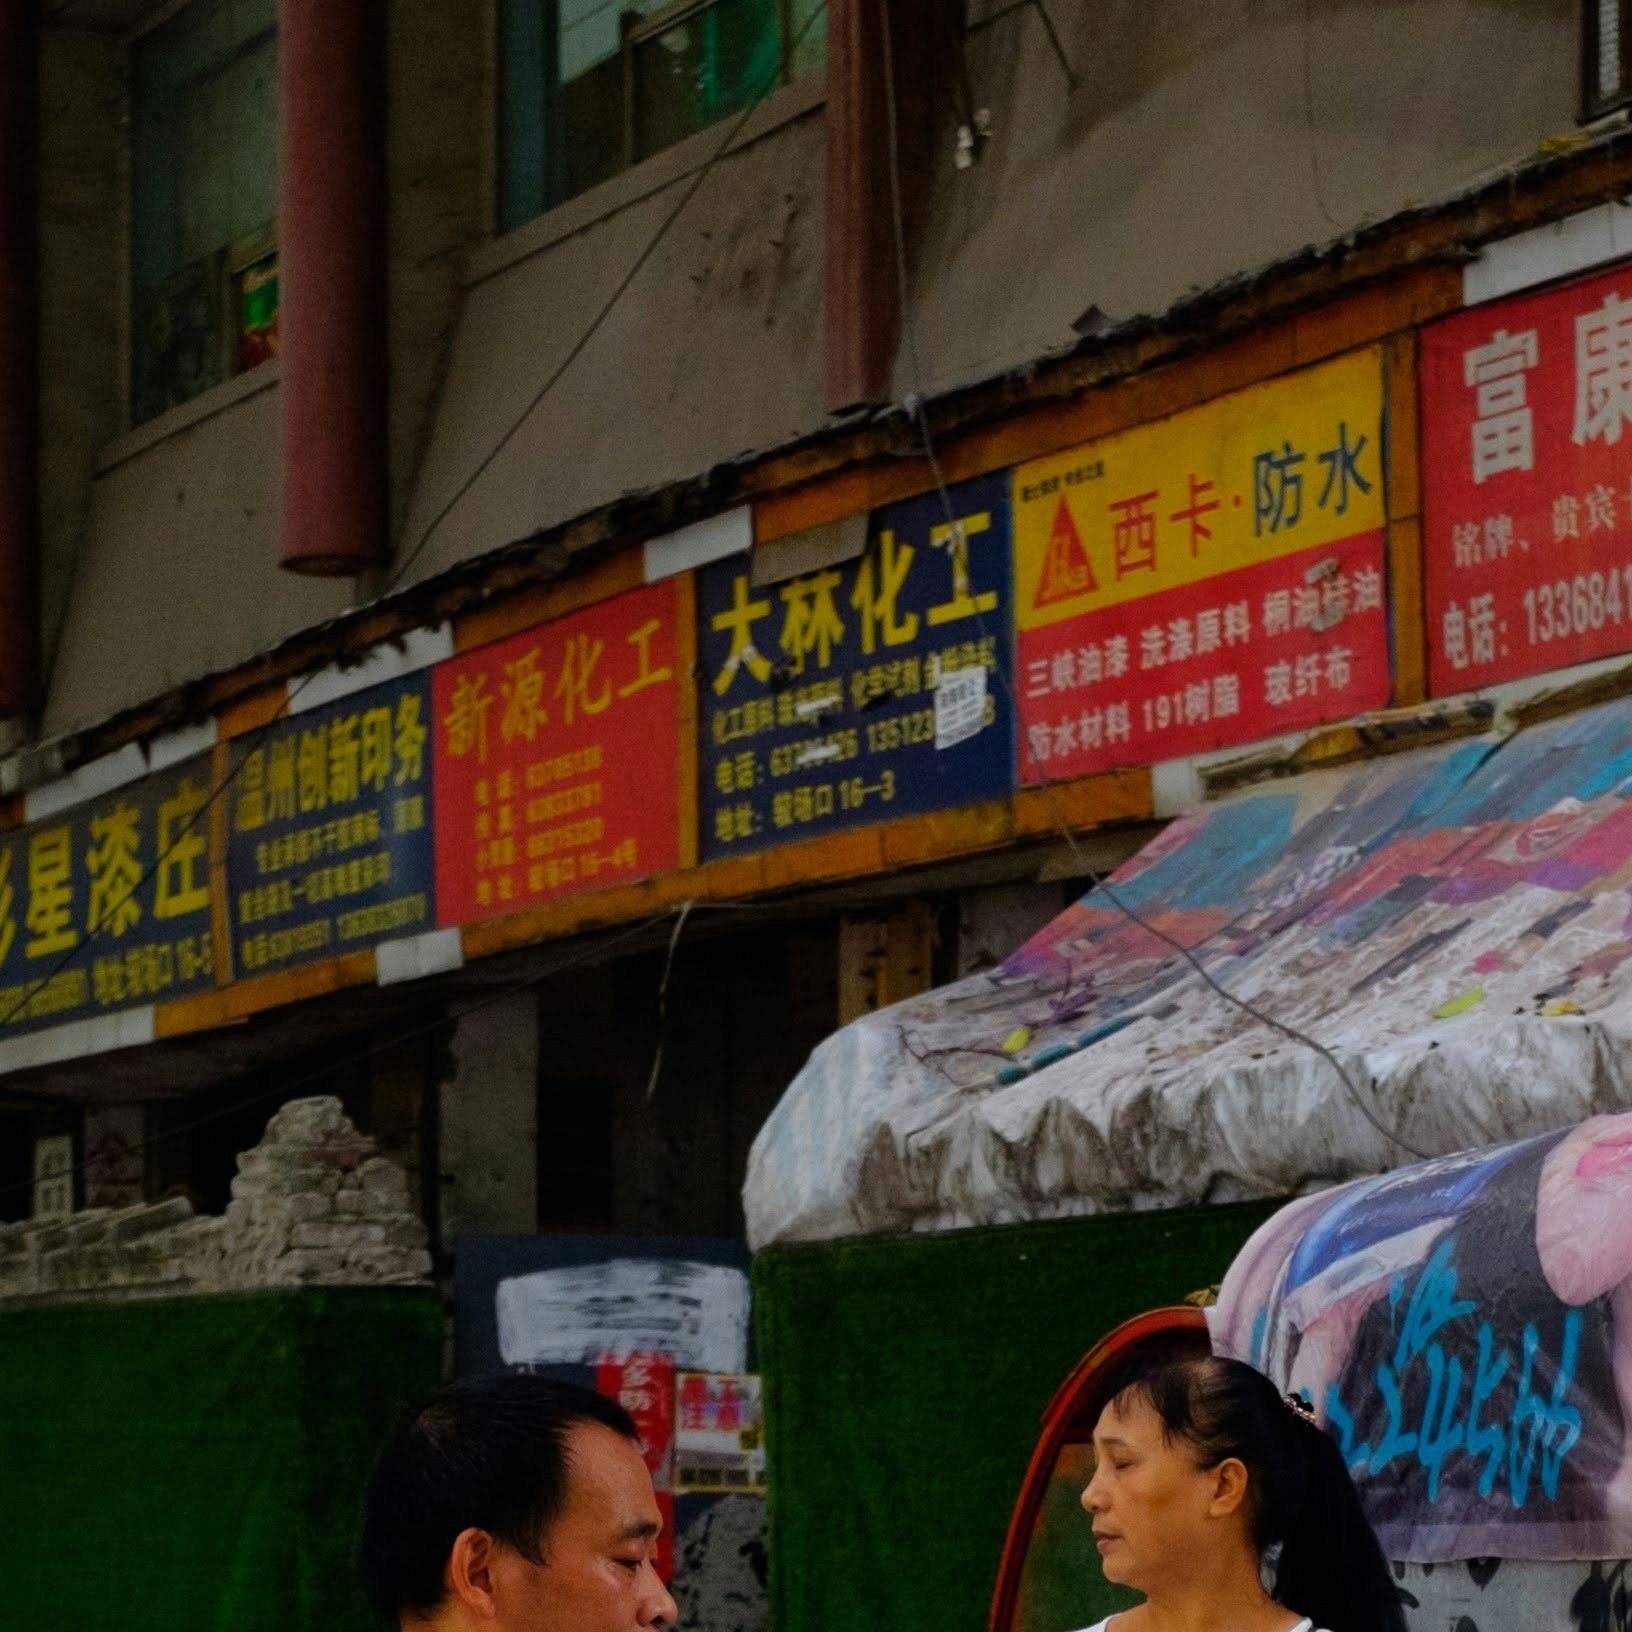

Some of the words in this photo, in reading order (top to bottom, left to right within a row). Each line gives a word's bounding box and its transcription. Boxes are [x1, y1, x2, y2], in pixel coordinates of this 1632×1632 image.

[711, 511, 998, 696] 大林化工
[444, 618, 673, 765] 新源化工
